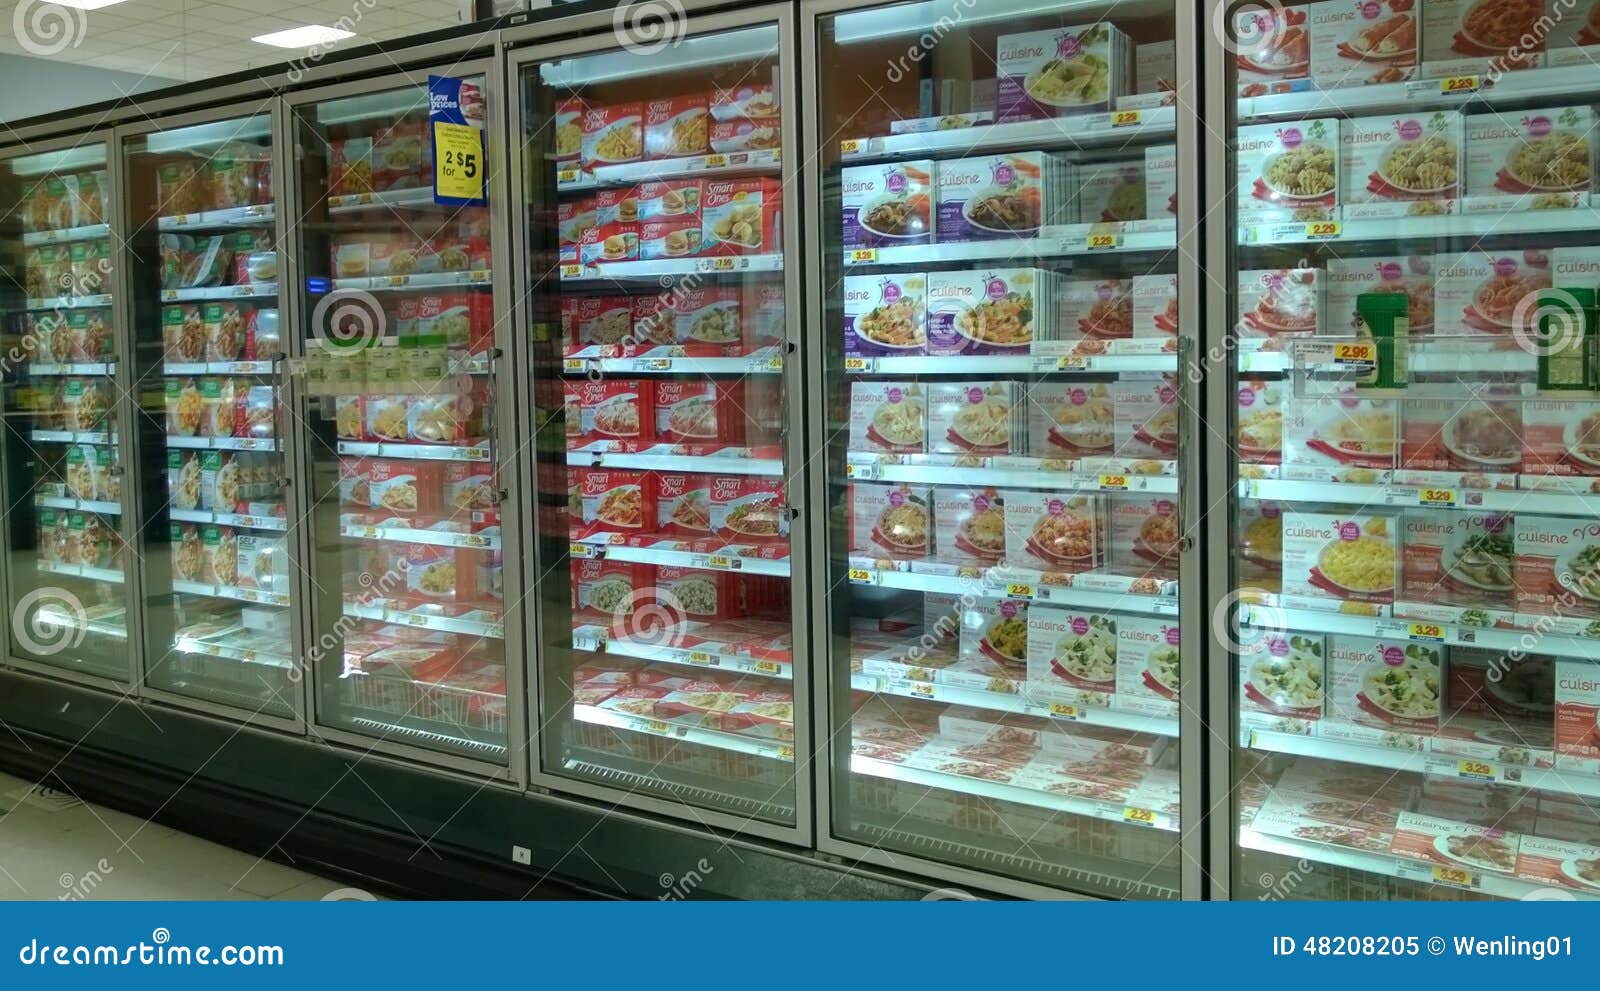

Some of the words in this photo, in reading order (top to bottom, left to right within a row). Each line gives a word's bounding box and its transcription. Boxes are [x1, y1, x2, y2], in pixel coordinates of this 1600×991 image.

[1312, 11, 1355, 25] cuisine
[1000, 47, 1043, 61] cuisine
[1448, 78, 1473, 90] 2.29
[430, 92, 448, 101] Low
[430, 101, 457, 110] prices
[648, 102, 672, 113] Smart
[585, 109, 608, 122] Smart
[648, 112, 669, 123] Ones
[1117, 112, 1137, 122] 2.29
[585, 120, 606, 131] Ones
[1343, 132, 1392, 144] cuisine
[1470, 127, 1520, 141] cuisine
[1238, 140, 1274, 151] uisine
[446, 151, 453, 164] 2
[456, 151, 477, 178] $5
[442, 166, 455, 177] for
[641, 182, 659, 192] Smart
[707, 182, 734, 194] Smart
[842, 181, 874, 193] uisine
[641, 190, 656, 200] Ones
[707, 193, 730, 206] Ones
[643, 223, 662, 233] Smart
[1313, 223, 1336, 234] 2.29
[643, 231, 659, 240] Ones
[1092, 235, 1112, 246] 2.29
[855, 251, 872, 260] 3.29
[1329, 271, 1375, 282] cuisine
[1438, 266, 1488, 278] cuisine
[930, 286, 973, 298] cuisine
[422, 296, 442, 306] Smart
[636, 298, 658, 309] Smart
[422, 306, 439, 317] Ones
[636, 308, 656, 318] Ones
[583, 383, 607, 394] Smart
[658, 383, 683, 394] Smart
[585, 393, 604, 403] Ones
[659, 393, 680, 403] Ones
[371, 463, 390, 473] Smart
[372, 472, 389, 481] Ones
[586, 473, 609, 485] Smart
[660, 476, 686, 488] Smart
[1105, 476, 1125, 486] 2.29
[586, 483, 606, 493] Ones
[713, 479, 741, 491] Smart
[661, 486, 683, 496] Ones
[715, 489, 738, 499] Ones
[1426, 490, 1451, 501] 3.29
[855, 496, 885, 505] cuisine
[936, 501, 969, 510] cuisine
[1006, 503, 1042, 513] cuisine
[1113, 504, 1150, 514] cuisine
[1285, 527, 1332, 540] cuisine
[1407, 522, 1455, 535] cuisine
[1517, 531, 1569, 545] cuisine
[580, 561, 602, 571] Smart
[581, 569, 600, 579] Ones
[852, 571, 869, 580] 2.29
[1011, 585, 1030, 594] 2.29
[1028, 620, 1066, 632] cuisine
[1415, 625, 1440, 636] 3.29
[1119, 629, 1160, 642] cuisine
[1328, 650, 1376, 664] cuisine
[1055, 704, 1073, 714] 2.29
[1465, 763, 1490, 775] 3.29
[1130, 809, 1152, 821] 2.29
[1402, 818, 1451, 832] cuisine
[1523, 841, 1577, 854] cuisine
